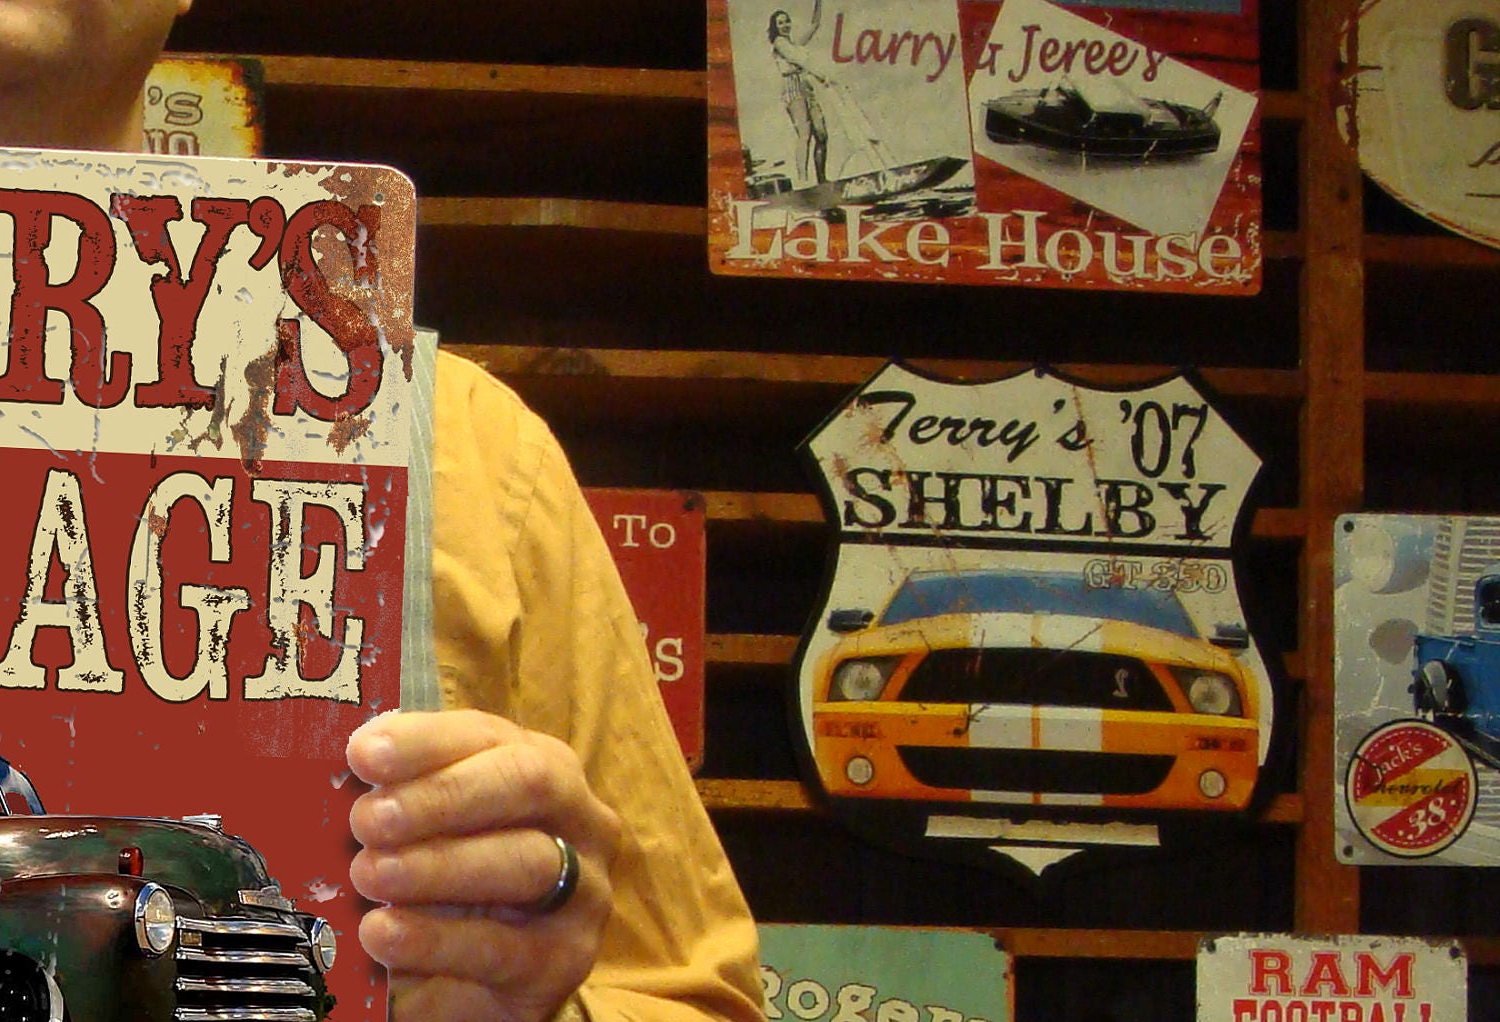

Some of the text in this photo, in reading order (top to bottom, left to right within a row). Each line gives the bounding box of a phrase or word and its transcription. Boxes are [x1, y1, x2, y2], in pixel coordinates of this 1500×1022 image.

[831, 13, 957, 83] Larry
[726, 200, 1246, 282] Lake House
[855, 389, 1096, 463] Terry's
[842, 467, 1227, 542] SHELBY
[1083, 558, 1143, 590] GT
[1248, 948, 1416, 999] RAM
